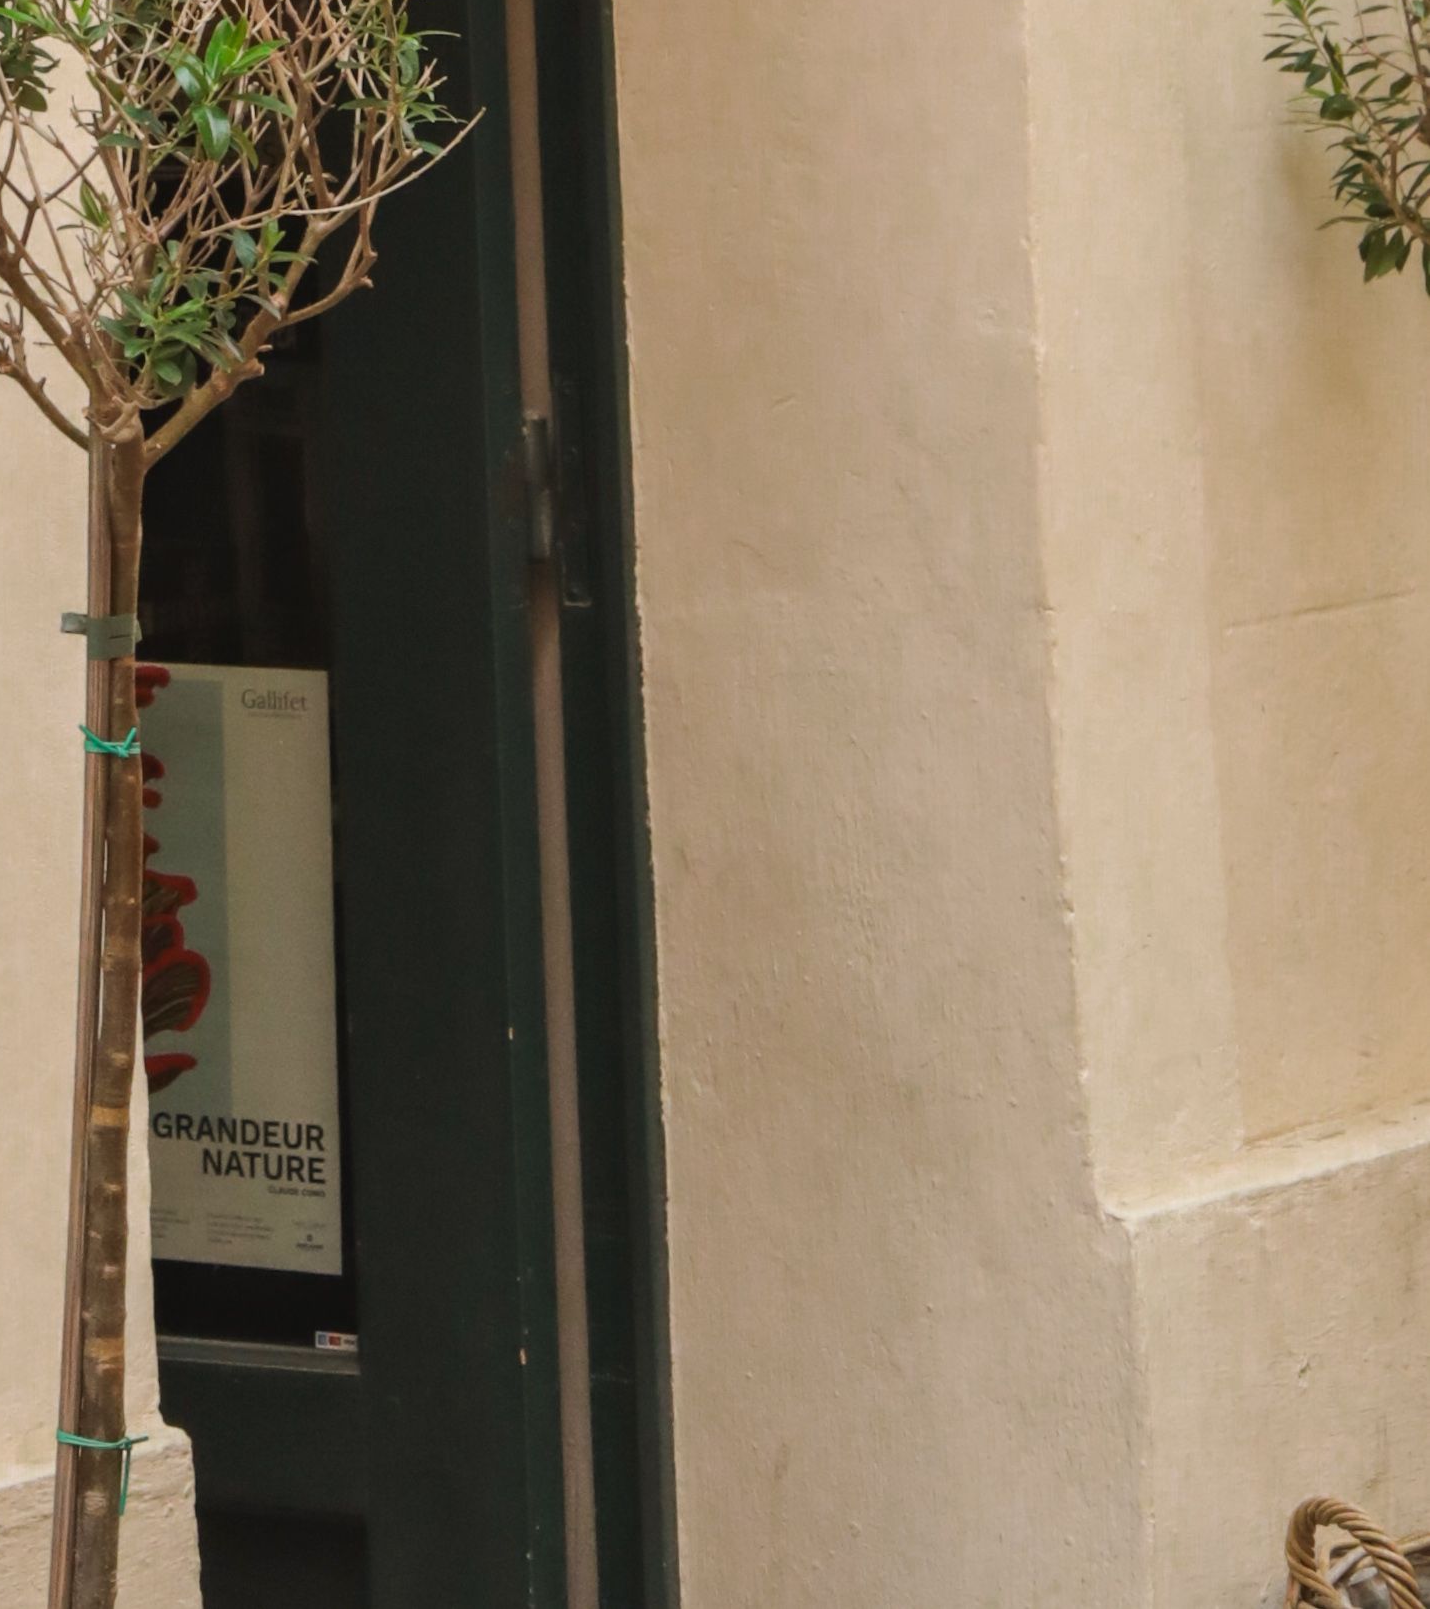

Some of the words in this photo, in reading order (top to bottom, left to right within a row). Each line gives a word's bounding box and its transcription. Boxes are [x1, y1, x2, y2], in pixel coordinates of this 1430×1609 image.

[241, 688, 308, 712] Gallifet
[152, 1111, 326, 1152] GRANDEUR
[202, 1148, 327, 1185] NATURE
